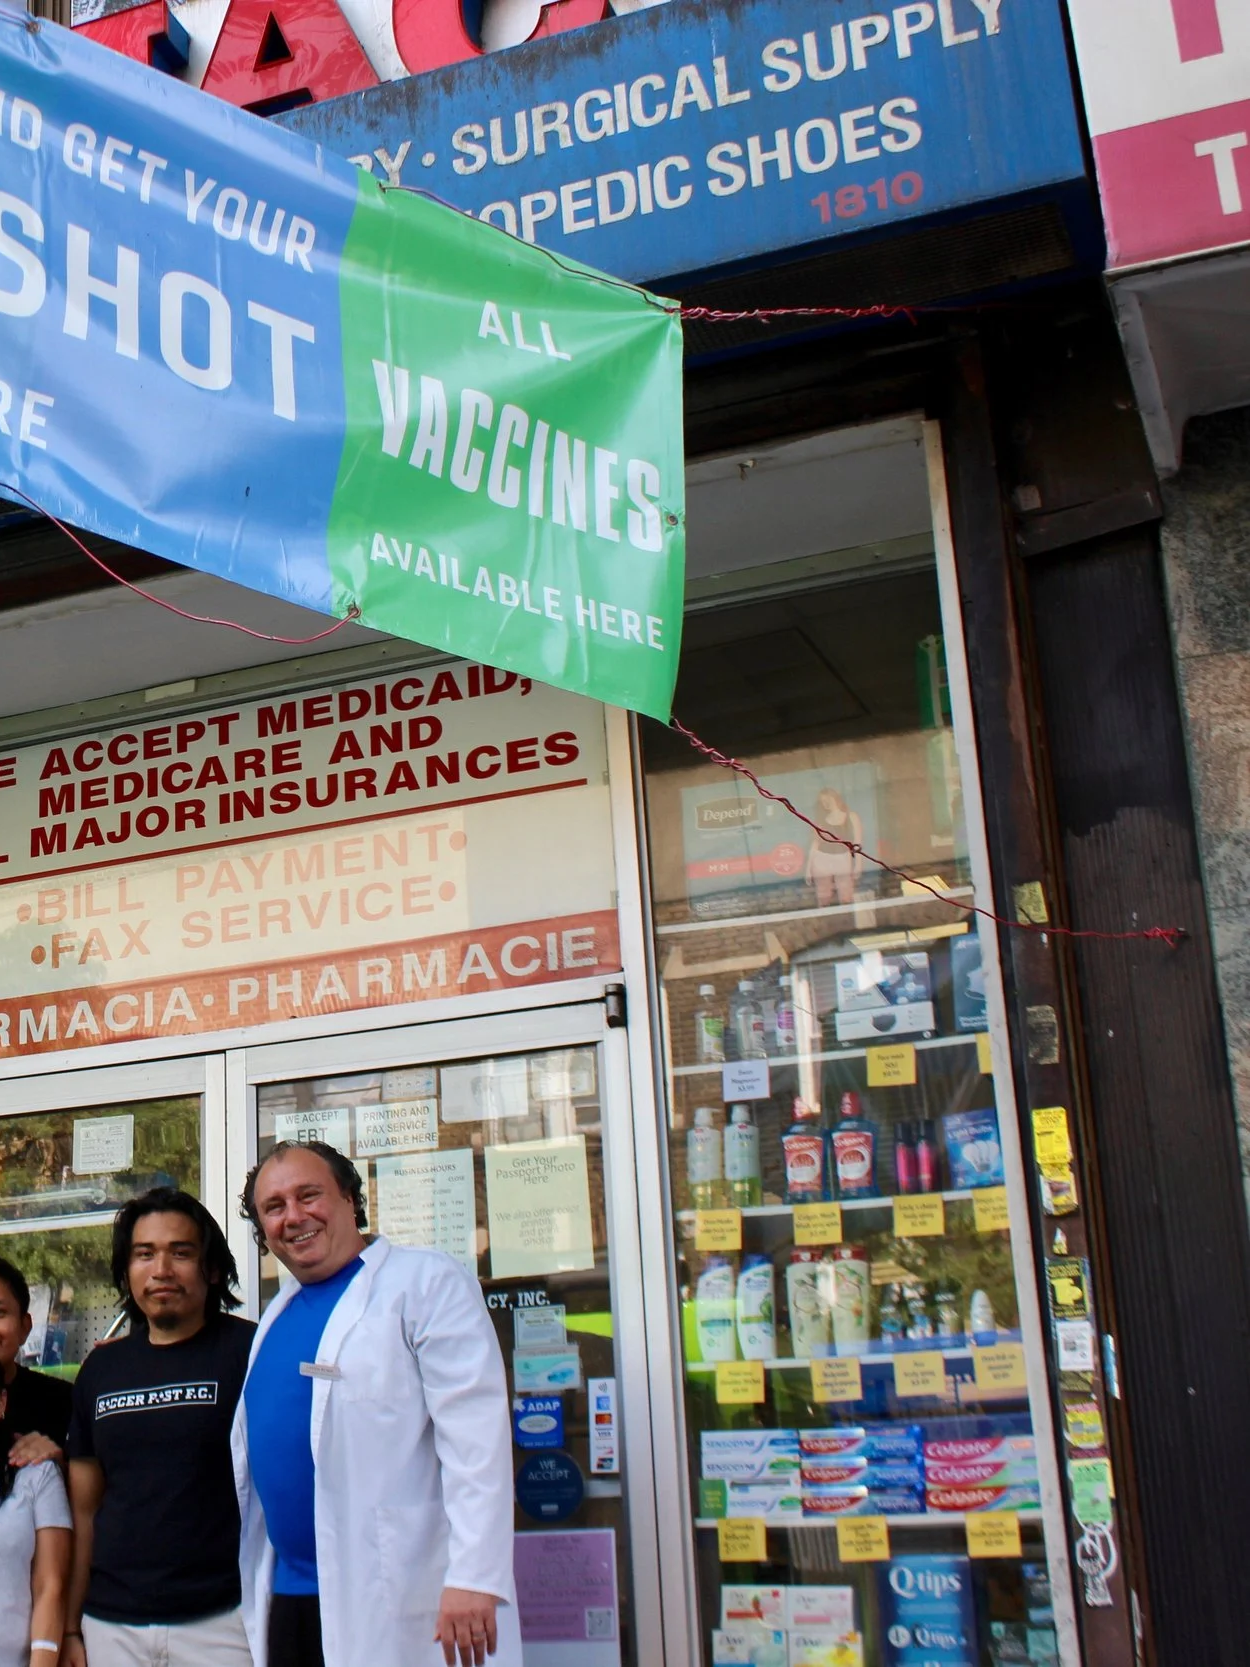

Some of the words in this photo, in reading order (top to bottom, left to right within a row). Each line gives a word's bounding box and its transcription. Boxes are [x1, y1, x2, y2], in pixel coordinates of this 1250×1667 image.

[451, 55, 750, 177] SURGICAL
[761, 0, 1002, 93] SUPPLY
[707, 96, 924, 198] SHOES
[62, 123, 168, 205] GET
[184, 168, 316, 274] YOUR
[809, 170, 926, 227] 1810
[478, 300, 572, 361] ALL
[371, 358, 665, 553] VACCINES
[369, 531, 564, 622] AVAILABLE
[575, 593, 665, 651] HERE
[40, 711, 241, 780] ACCEPT
[257, 663, 534, 739] MEDICAID,
[37, 740, 303, 819] MEDICARE
[329, 713, 444, 766] AND
[29, 799, 208, 860] MAJOR
[218, 730, 582, 826] INSURANCES
[703, 803, 756, 823] Depend
[36, 875, 144, 927] BILL
[175, 822, 449, 902] PAYMENT
[51, 918, 152, 970] FAX
[181, 881, 435, 951] SERVICE
[227, 925, 600, 1017] PHARMACIE
[285, 1114, 300, 1125] WE
[301, 1110, 339, 1123] ACCEPT
[363, 1109, 408, 1121] PRINTING
[410, 1106, 430, 1117] AND
[366, 1124, 385, 1134] FAX
[387, 1119, 428, 1133] SERVICE
[357, 1135, 410, 1150] AVAILABLE
[411, 1132, 438, 1144] HERE
[394, 1167, 430, 1177] BUSINESS
[430, 1164, 456, 1173] HOURS
[495, 1167, 542, 1179] Passport
[543, 1162, 576, 1174] Photo
[512, 1157, 531, 1168] Get
[533, 1155, 558, 1165] Your
[523, 1175, 549, 1185] Here
[517, 1291, 551, 1307] INC.
[527, 1401, 561, 1412] ADAP
[528, 1469, 570, 1480] ACCEPT
[539, 1459, 556, 1470] WE
